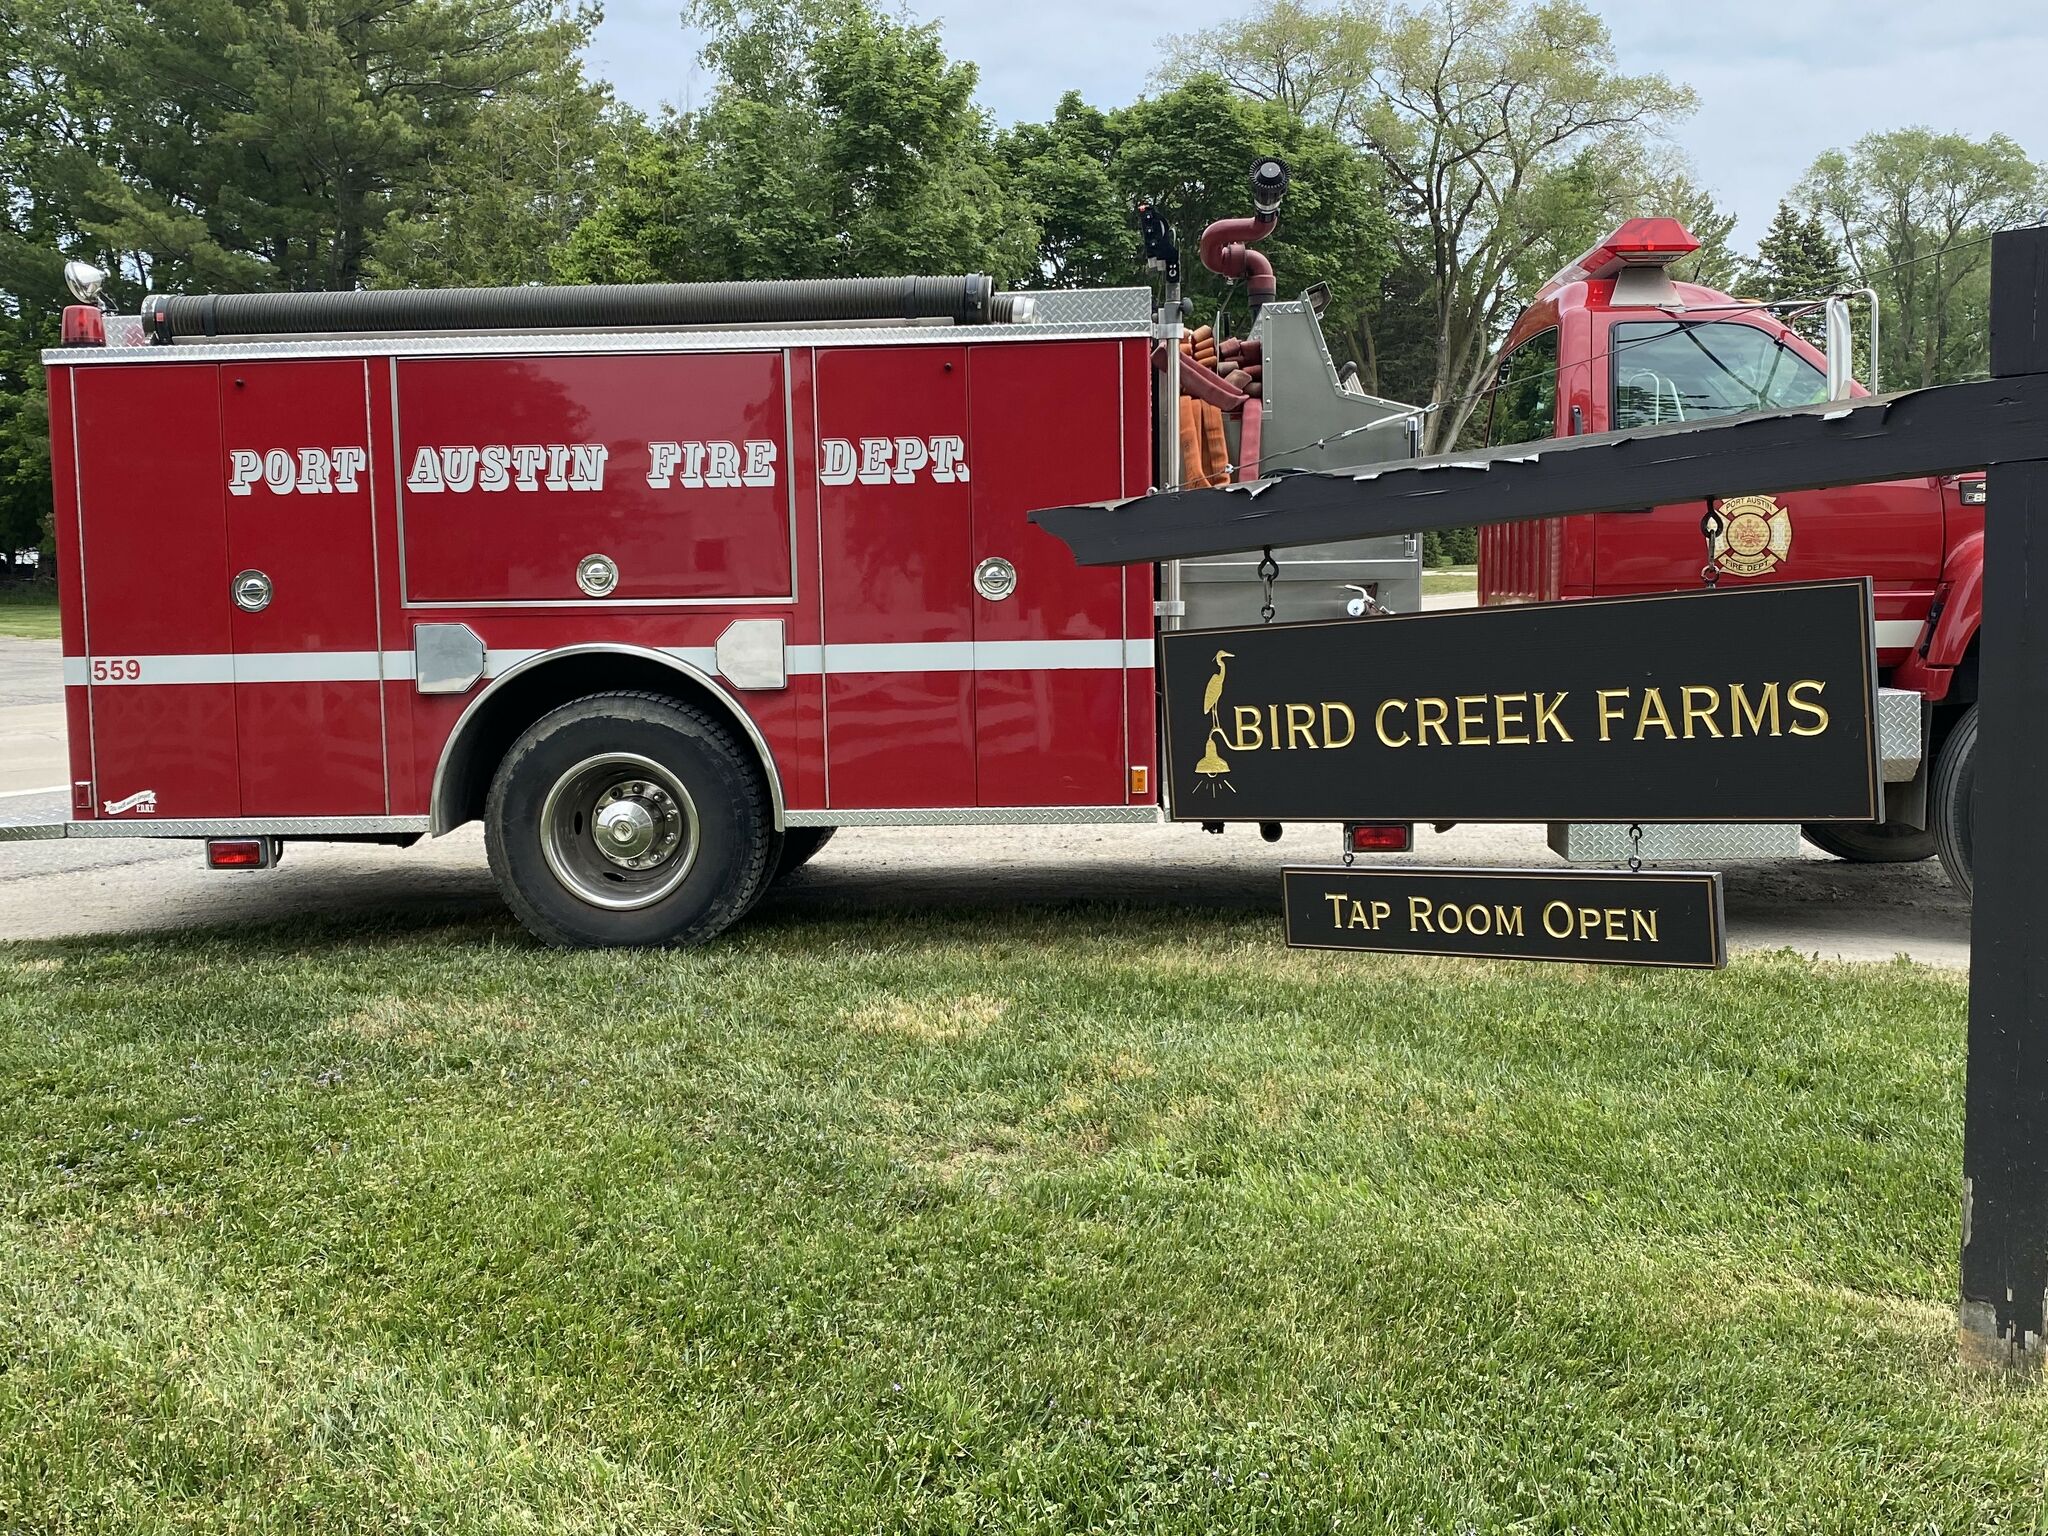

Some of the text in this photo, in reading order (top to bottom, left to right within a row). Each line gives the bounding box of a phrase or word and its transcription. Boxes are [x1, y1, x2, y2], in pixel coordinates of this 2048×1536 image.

[228, 435, 970, 496] PORT AUSTIN FIRE DEPT.
[1725, 497, 1773, 512] PORT AUSTIN
[1725, 558, 1744, 571] FIRE
[93, 659, 141, 681] 559
[1234, 680, 1830, 751] BIRD CREEK FARMS
